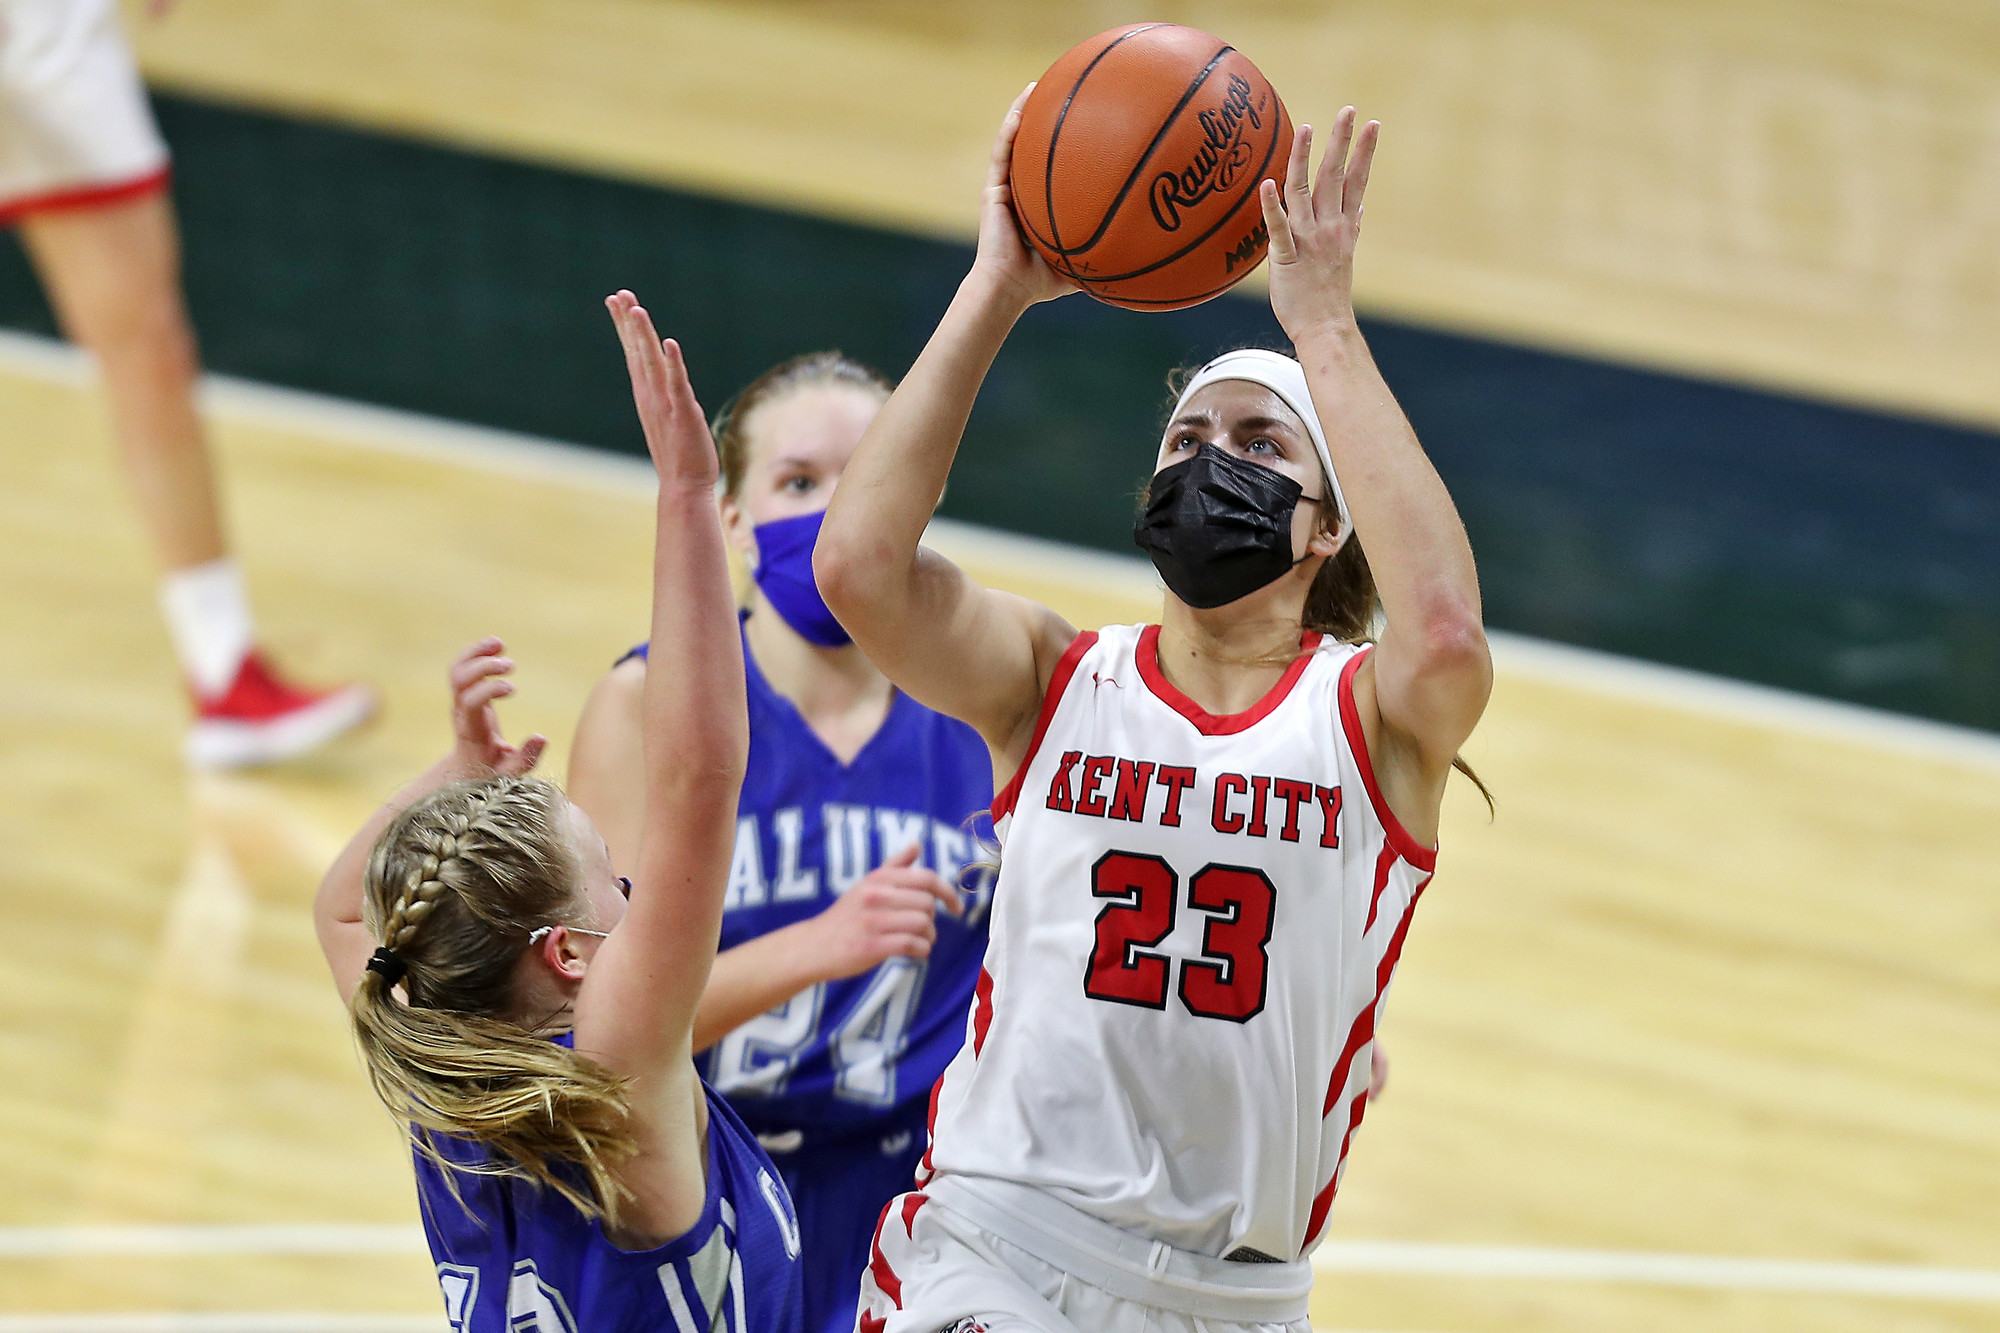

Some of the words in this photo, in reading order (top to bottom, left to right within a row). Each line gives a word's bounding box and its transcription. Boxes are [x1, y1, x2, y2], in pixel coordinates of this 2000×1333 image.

[1150, 73, 1260, 232] Rawlings
[1046, 750, 1196, 828] KENT
[1211, 772, 1342, 849] CITY
[1083, 849, 1277, 1024] 23
[708, 954, 928, 1107] 24
